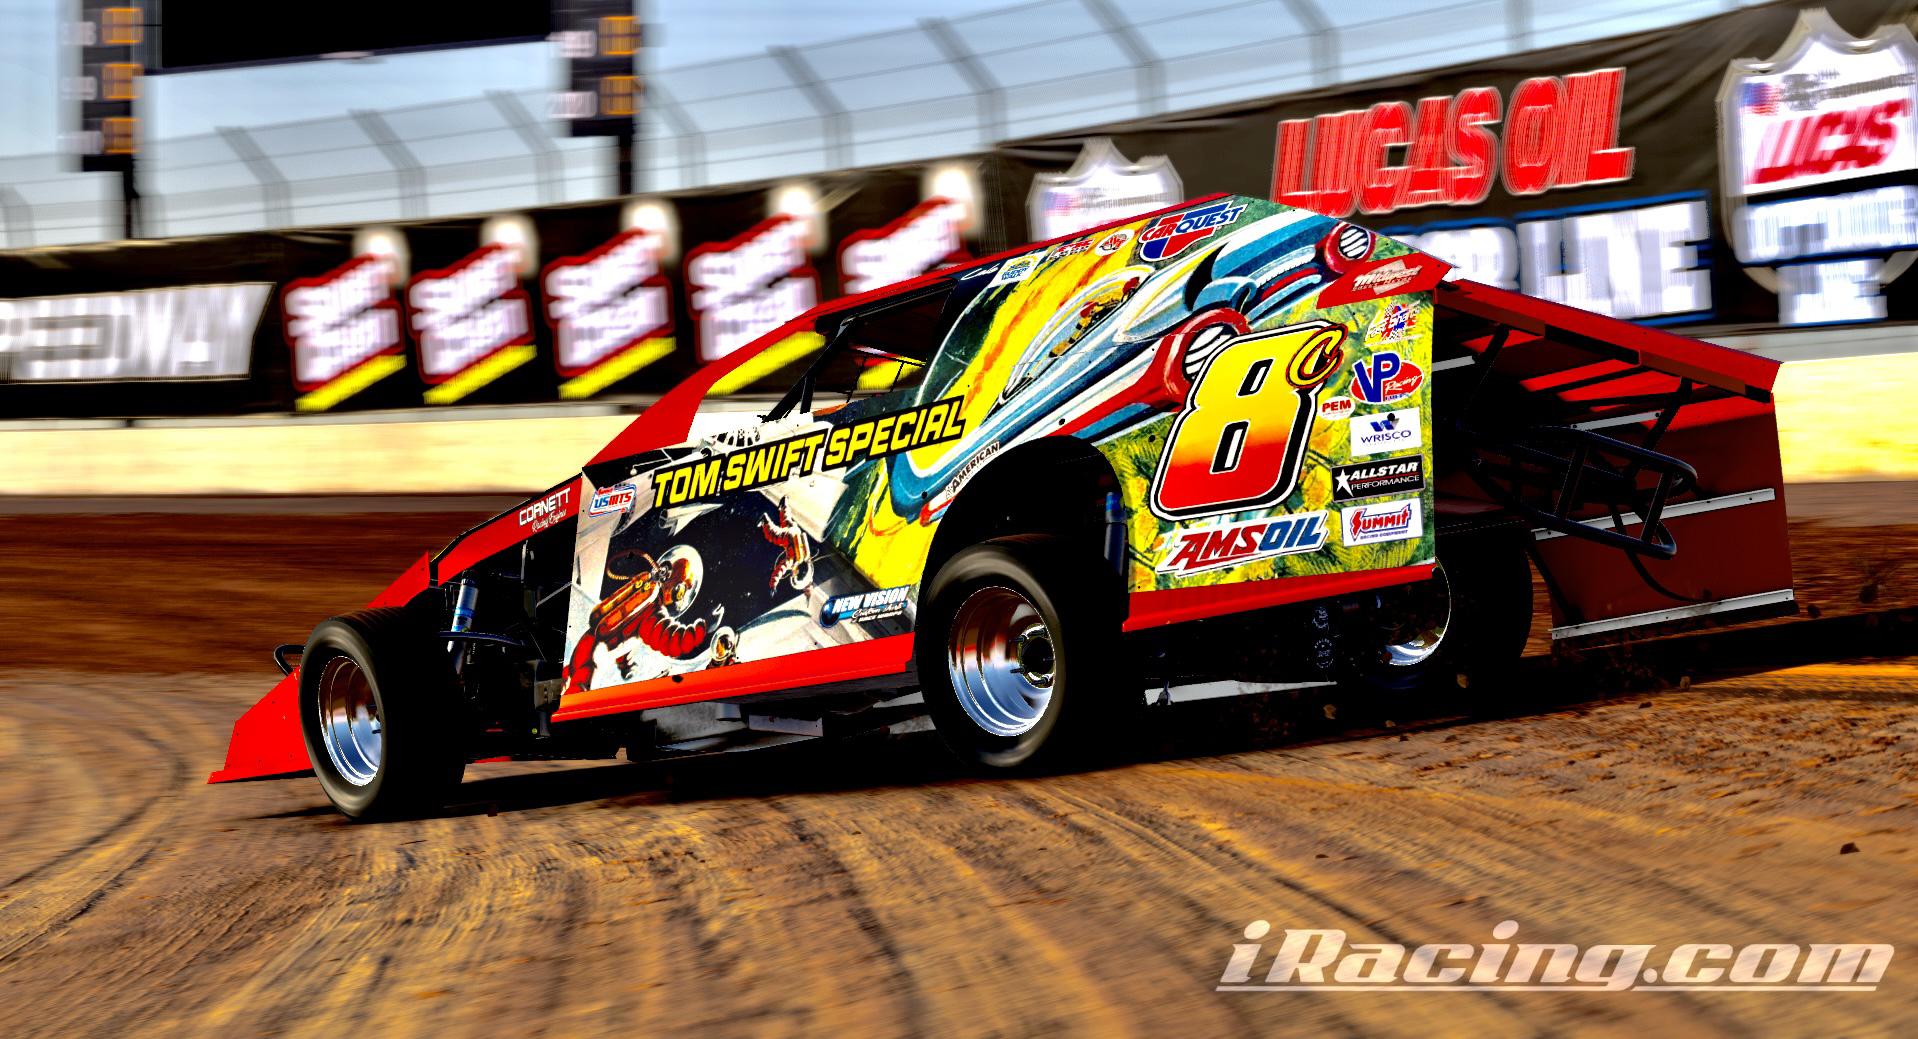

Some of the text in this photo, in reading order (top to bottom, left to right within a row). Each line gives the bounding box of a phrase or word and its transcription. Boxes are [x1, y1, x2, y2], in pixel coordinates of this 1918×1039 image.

[1270, 67, 1636, 218] LUCAS OIL
[1141, 206, 1244, 241] CARQUEST
[1354, 353, 1401, 403] VP
[1322, 399, 1351, 412] PEM
[652, 400, 965, 508] TOM SWIFT SPECIAL
[1361, 429, 1412, 444] WRISCO
[951, 442, 999, 493] AMERICAN
[1350, 461, 1418, 481] ALLSTAR
[1350, 475, 1420, 491] PERFORMANCE
[519, 487, 571, 526] CORNETT
[594, 491, 633, 509] USMTS
[1169, 515, 1324, 571] AMSOIL
[831, 594, 865, 614] NEW
[863, 585, 910, 609] VISION
